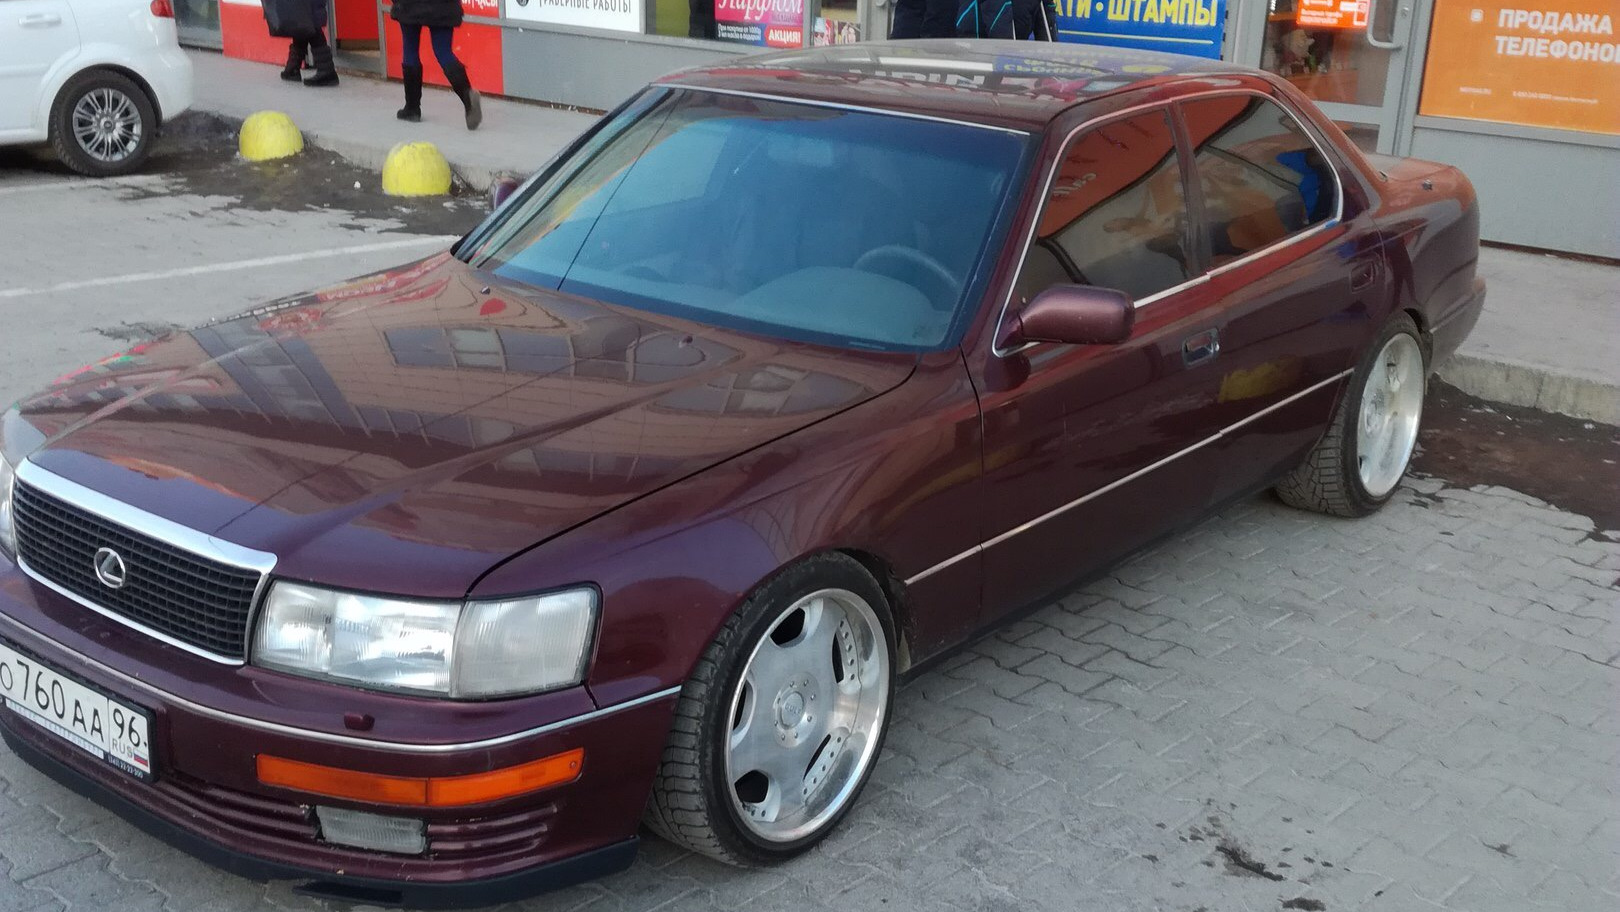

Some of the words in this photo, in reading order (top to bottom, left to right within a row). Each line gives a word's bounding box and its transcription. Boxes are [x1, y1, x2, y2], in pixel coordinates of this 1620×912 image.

[1107, 0, 1217, 26] ШТАМПЫ
[1498, 8, 1613, 35] ПРОДАЖА
[768, 28, 801, 44] АКЦИЯ!
[112, 737, 134, 758] RUS
